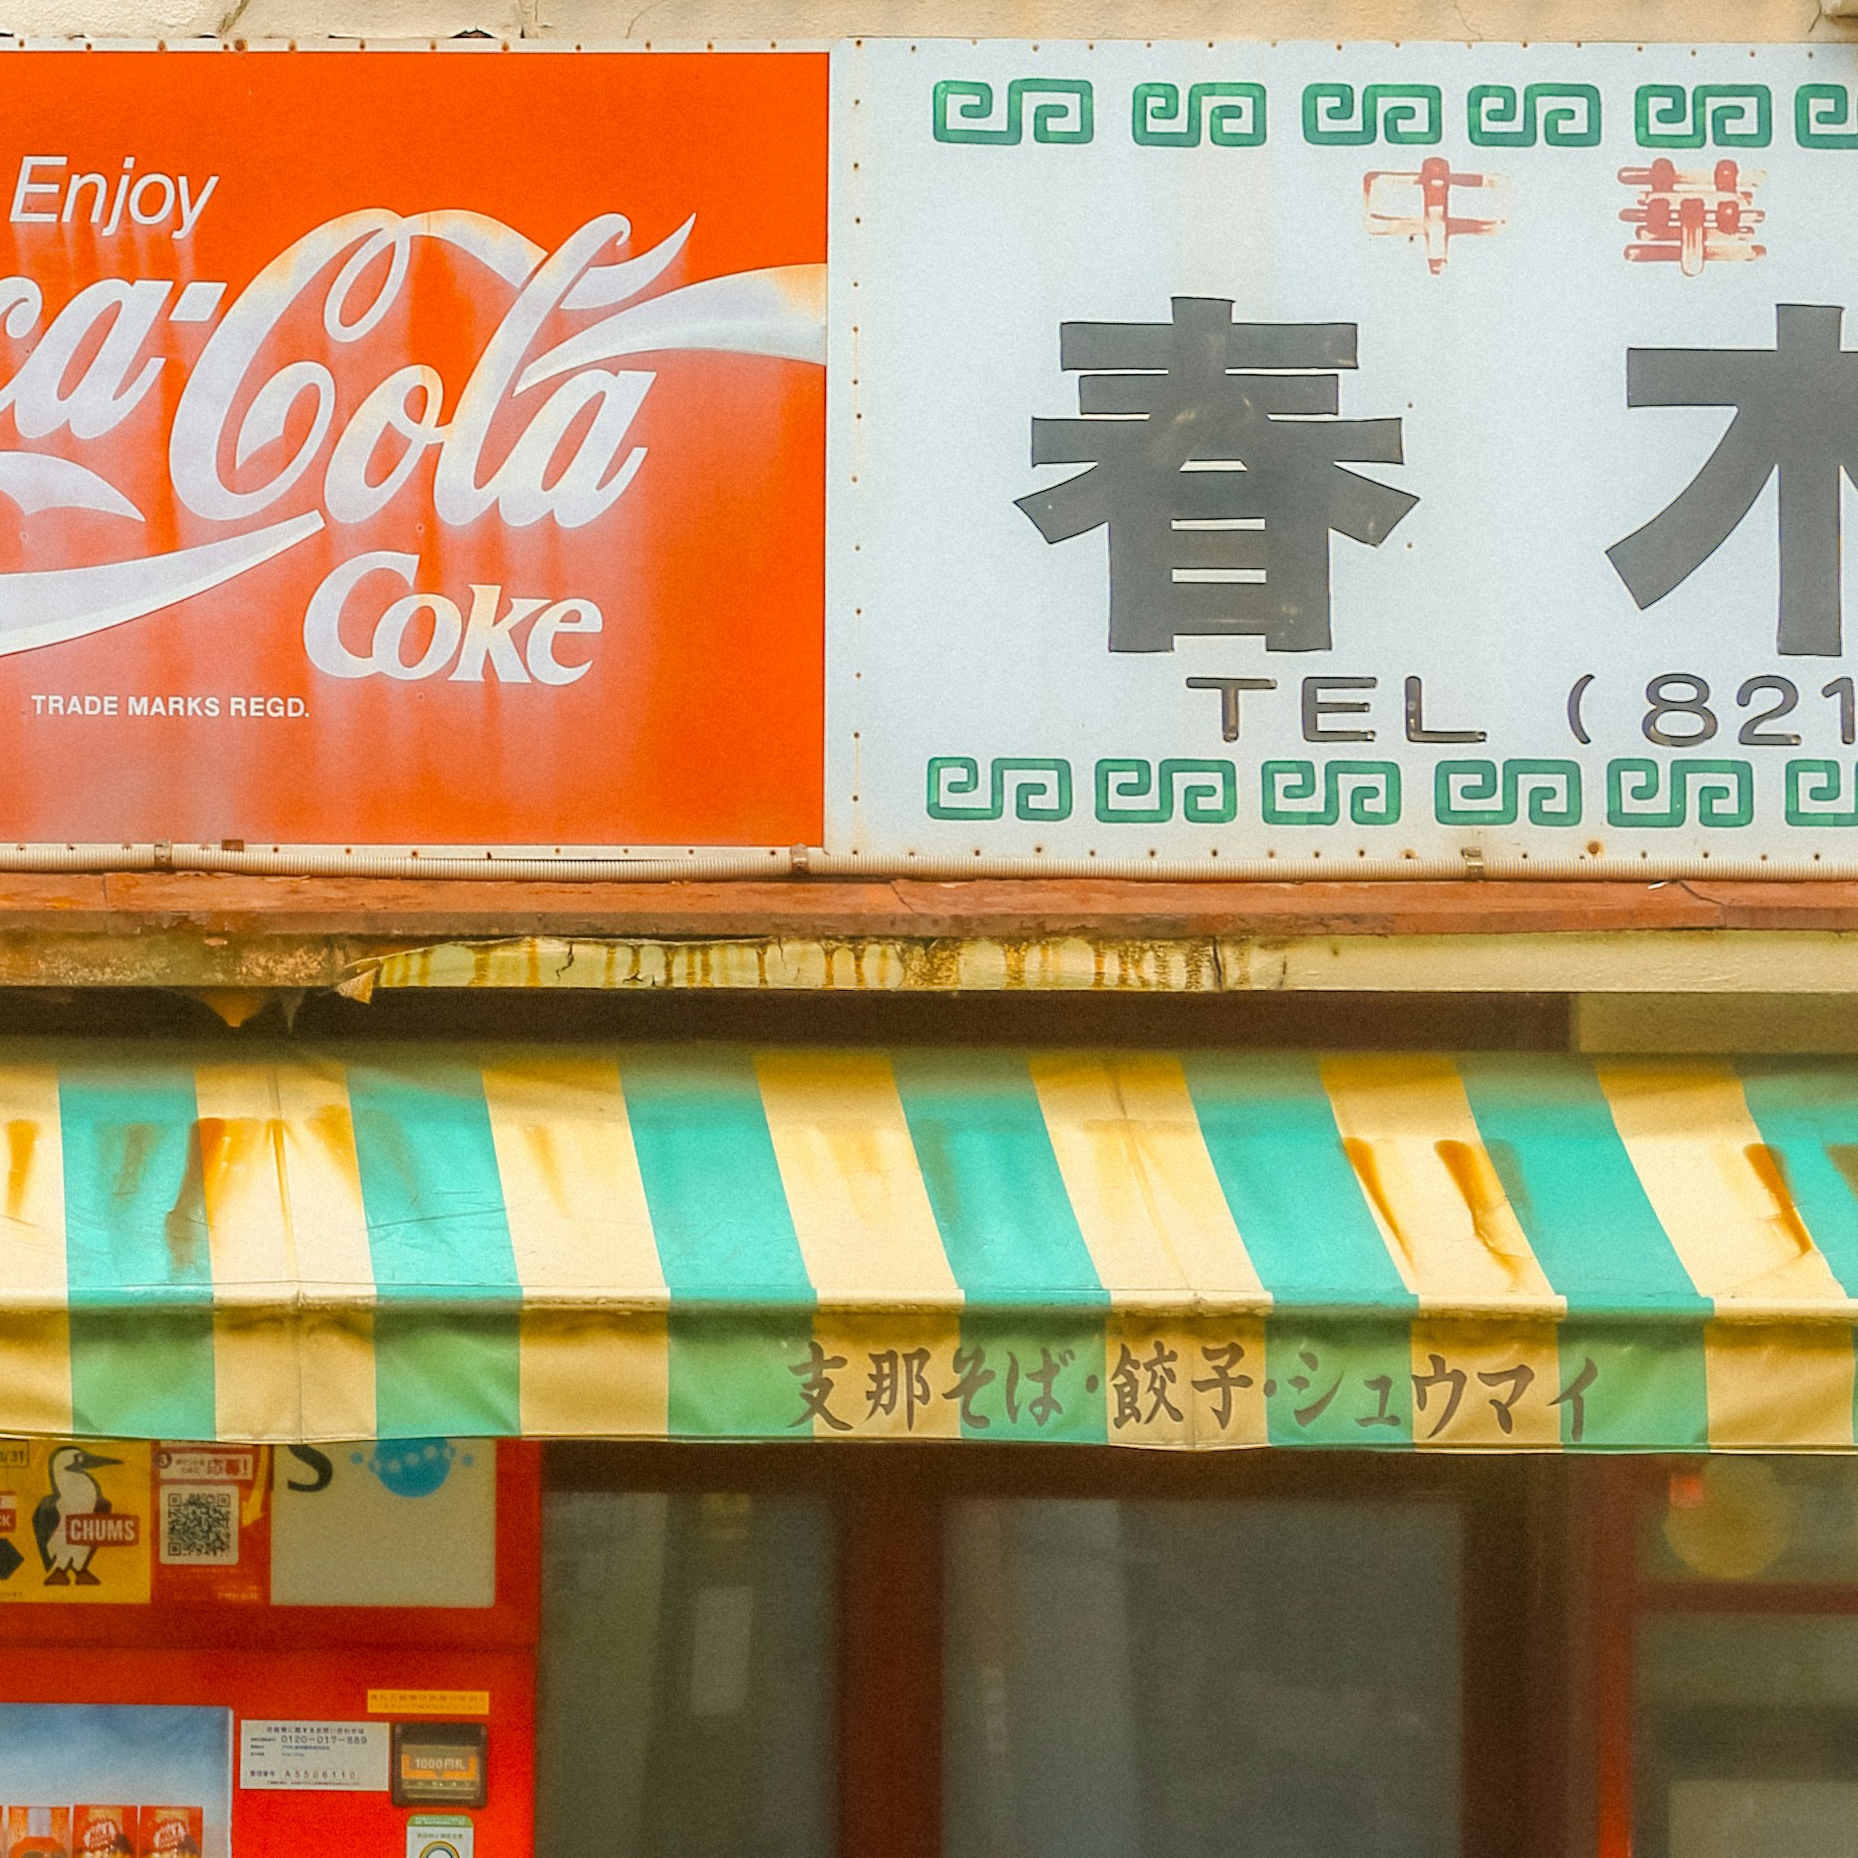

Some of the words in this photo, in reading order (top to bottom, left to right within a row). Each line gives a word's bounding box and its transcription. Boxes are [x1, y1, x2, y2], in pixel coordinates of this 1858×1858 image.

[8, 154, 219, 240] Enjoy
[303, 550, 604, 687] Coke
[31, 694, 119, 718] TRADE
[127, 694, 222, 718] MARKS
[229, 694, 310, 718] REGD.
[1186, 676, 1486, 744] TEL
[69, 1519, 135, 1542] CHUMS
